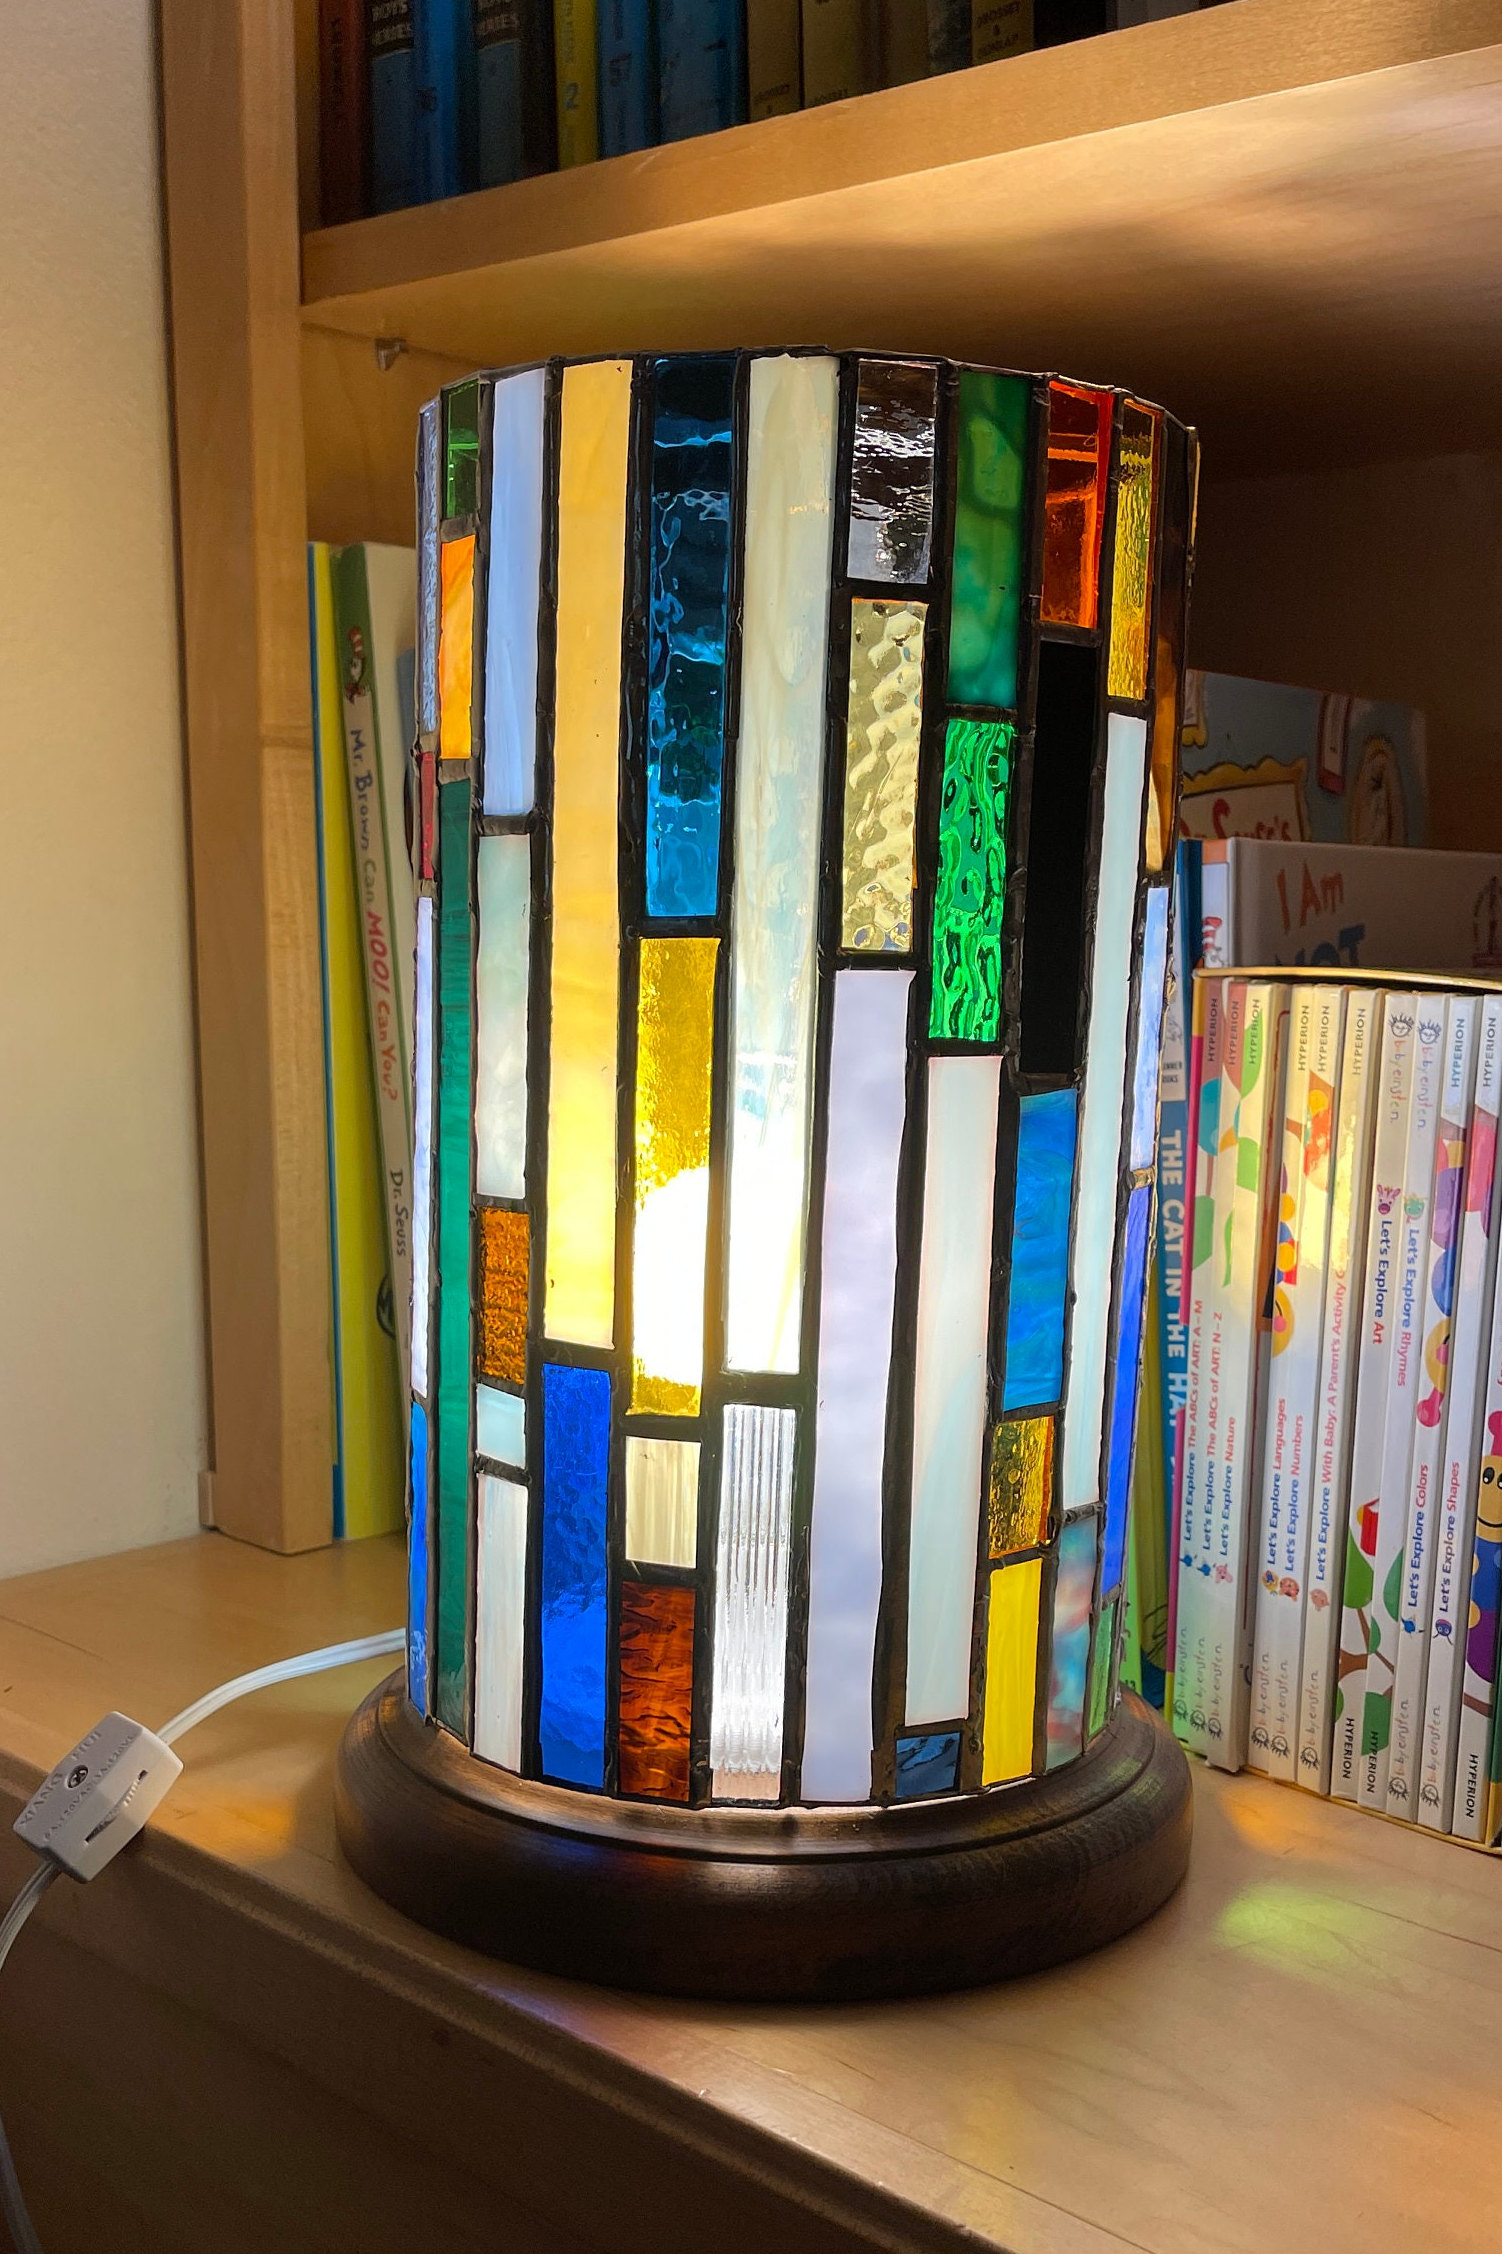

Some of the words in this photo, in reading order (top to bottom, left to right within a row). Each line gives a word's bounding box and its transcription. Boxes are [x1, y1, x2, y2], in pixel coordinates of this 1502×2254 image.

[350, 730, 367, 767] Mr.
[355, 769, 373, 851] Brown
[364, 859, 377, 902] Can
[367, 911, 390, 994] MOO!
[377, 1000, 391, 1042] Can
[1207, 998, 1218, 1064] HYPERION
[1227, 1001, 1239, 1066] HYPERION
[1248, 1000, 1260, 1066] HYPERION
[1297, 1004, 1309, 1072] HYPERION
[1317, 1004, 1330, 1073] HYPERION
[1353, 1007, 1367, 1075] HYPERION
[381, 1044, 398, 1101] You?
[1389, 1039, 1407, 1067] bby
[1416, 1046, 1433, 1074] bby
[1450, 1018, 1466, 1088] HYPERION
[1482, 1017, 1498, 1088] HYPERION
[1390, 1069, 1408, 1121] einsten
[1418, 1076, 1433, 1128] einsten
[1161, 1130, 1183, 1185] THE
[391, 1169, 404, 1199] Dr.
[395, 1203, 409, 1257] Seuss
[1162, 1198, 1185, 1257] CAT
[1380, 1220, 1392, 1255] Let's
[1407, 1229, 1420, 1264] Let's
[1165, 1267, 1183, 1297] IN
[1375, 1260, 1389, 1318] Explore
[1402, 1269, 1416, 1328] Explore
[1193, 1300, 1202, 1314] M
[1332, 1282, 1346, 1336] Activity
[1193, 1326, 1201, 1337] A
[1212, 1332, 1221, 1344] N
[1373, 1322, 1385, 1345] Art
[1190, 1372, 1199, 1386] of
[1328, 1338, 1341, 1392] Parent's
[1398, 1332, 1412, 1387] Rhymes
[1188, 1389, 1199, 1422] ABCs
[1209, 1378, 1219, 1394] of
[1327, 1395, 1337, 1407] A
[1208, 1397, 1218, 1430] ABCs
[1272, 1398, 1287, 1470] Languages
[1324, 1410, 1337, 1447] Baby:
[1187, 1425, 1196, 1449] The
[1206, 1432, 1216, 1457] The
[1225, 1416, 1236, 1462] Nature
[1290, 1415, 1304, 1476] Numbers
[1186, 1452, 1195, 1506] Explore
[1204, 1460, 1215, 1515] Explore
[1321, 1451, 1333, 1484] With
[1416, 1464, 1429, 1508] Colors
[1446, 1461, 1460, 1511] Shapes
[1221, 1465, 1232, 1520] Explore
[1268, 1473, 1281, 1529] Explore
[1286, 1479, 1299, 1535] Explore
[1317, 1487, 1330, 1544] Explore
[1184, 1508, 1193, 1541] Let's
[1202, 1518, 1211, 1550] Let's
[1220, 1523, 1230, 1556] Let's
[1411, 1511, 1426, 1569] Explore
[1442, 1515, 1456, 1574] Explore
[1267, 1532, 1277, 1565] Let's
[1285, 1538, 1295, 1572] Let's
[1315, 1547, 1326, 1581] Let's
[1408, 1573, 1420, 1607] Let's
[1440, 1577, 1452, 1613] Let's
[1194, 1639, 1206, 1684] einsten
[1210, 1645, 1222, 1691] einsten
[1255, 1655, 1269, 1700] einsten
[1194, 1688, 1206, 1710] bby
[1210, 1695, 1221, 1717] bby
[1275, 1662, 1288, 1709] einsten
[1305, 1673, 1319, 1719] einsten
[1255, 1704, 1269, 1726] bby
[1276, 1713, 1289, 1735] bby
[1305, 1723, 1319, 1746] bby
[1395, 1702, 1409, 1749] einsten
[1427, 1709, 1440, 1756] einsten
[1342, 1718, 1355, 1779] HYPERION
[1367, 1730, 1379, 1793] HYPERION
[1395, 1754, 1409, 1776] bby
[1427, 1760, 1440, 1783] bby
[1466, 1753, 1479, 1818] HYPERION
